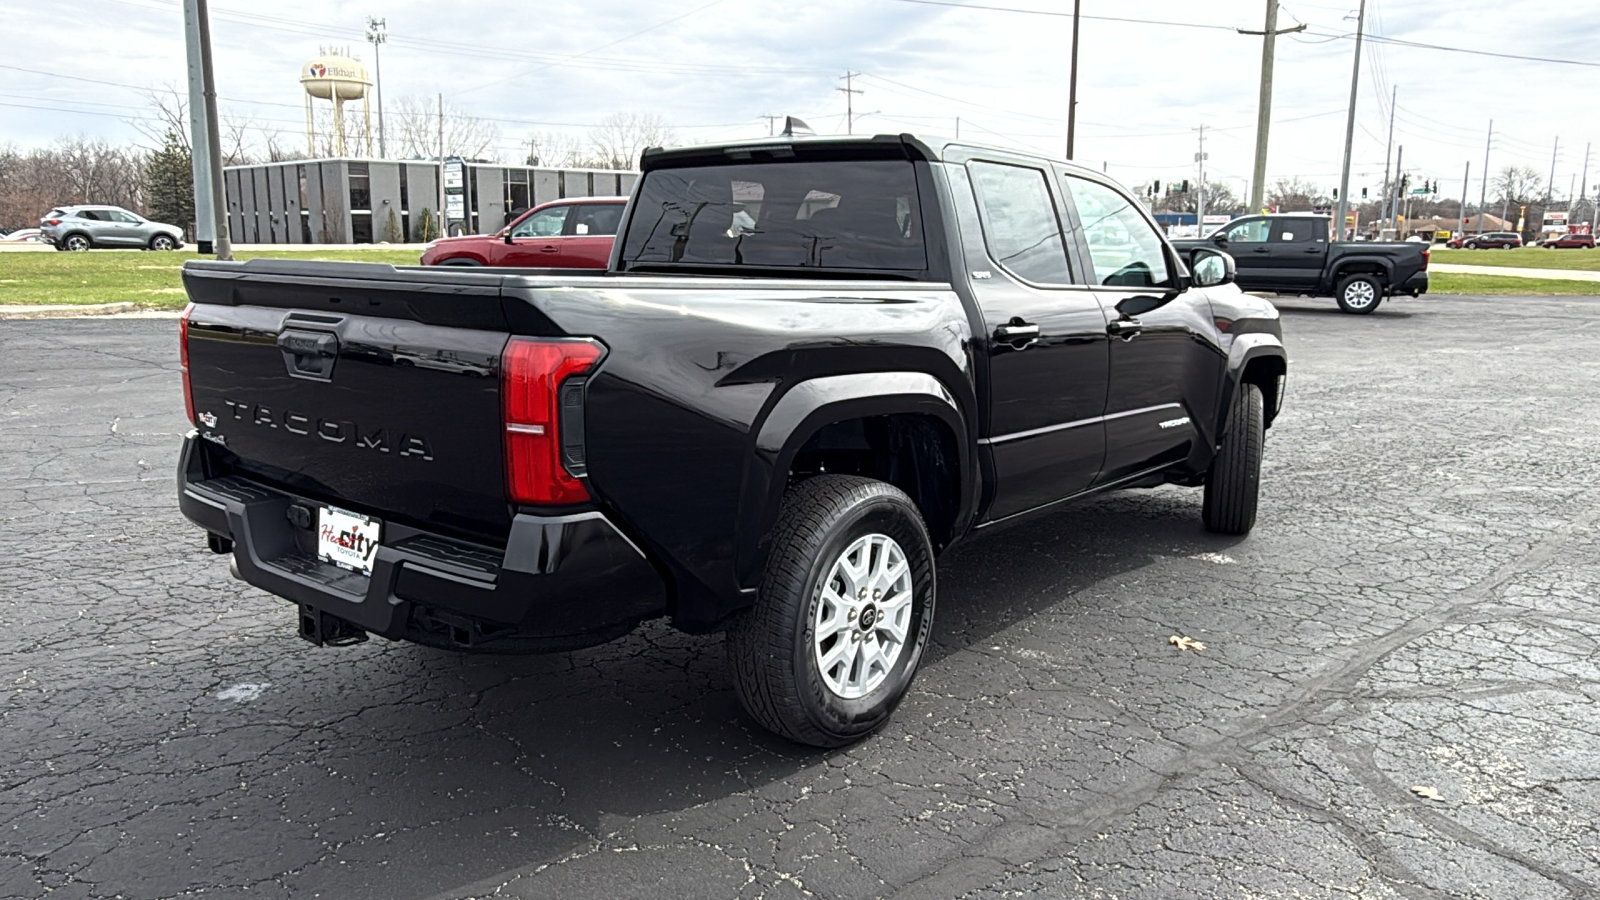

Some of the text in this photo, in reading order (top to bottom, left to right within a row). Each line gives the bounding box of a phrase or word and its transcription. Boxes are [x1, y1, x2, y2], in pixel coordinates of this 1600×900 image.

[327, 67, 356, 78] Elkhart
[224, 399, 434, 461] TACOMA
[336, 546, 361, 560] TOYOTA
